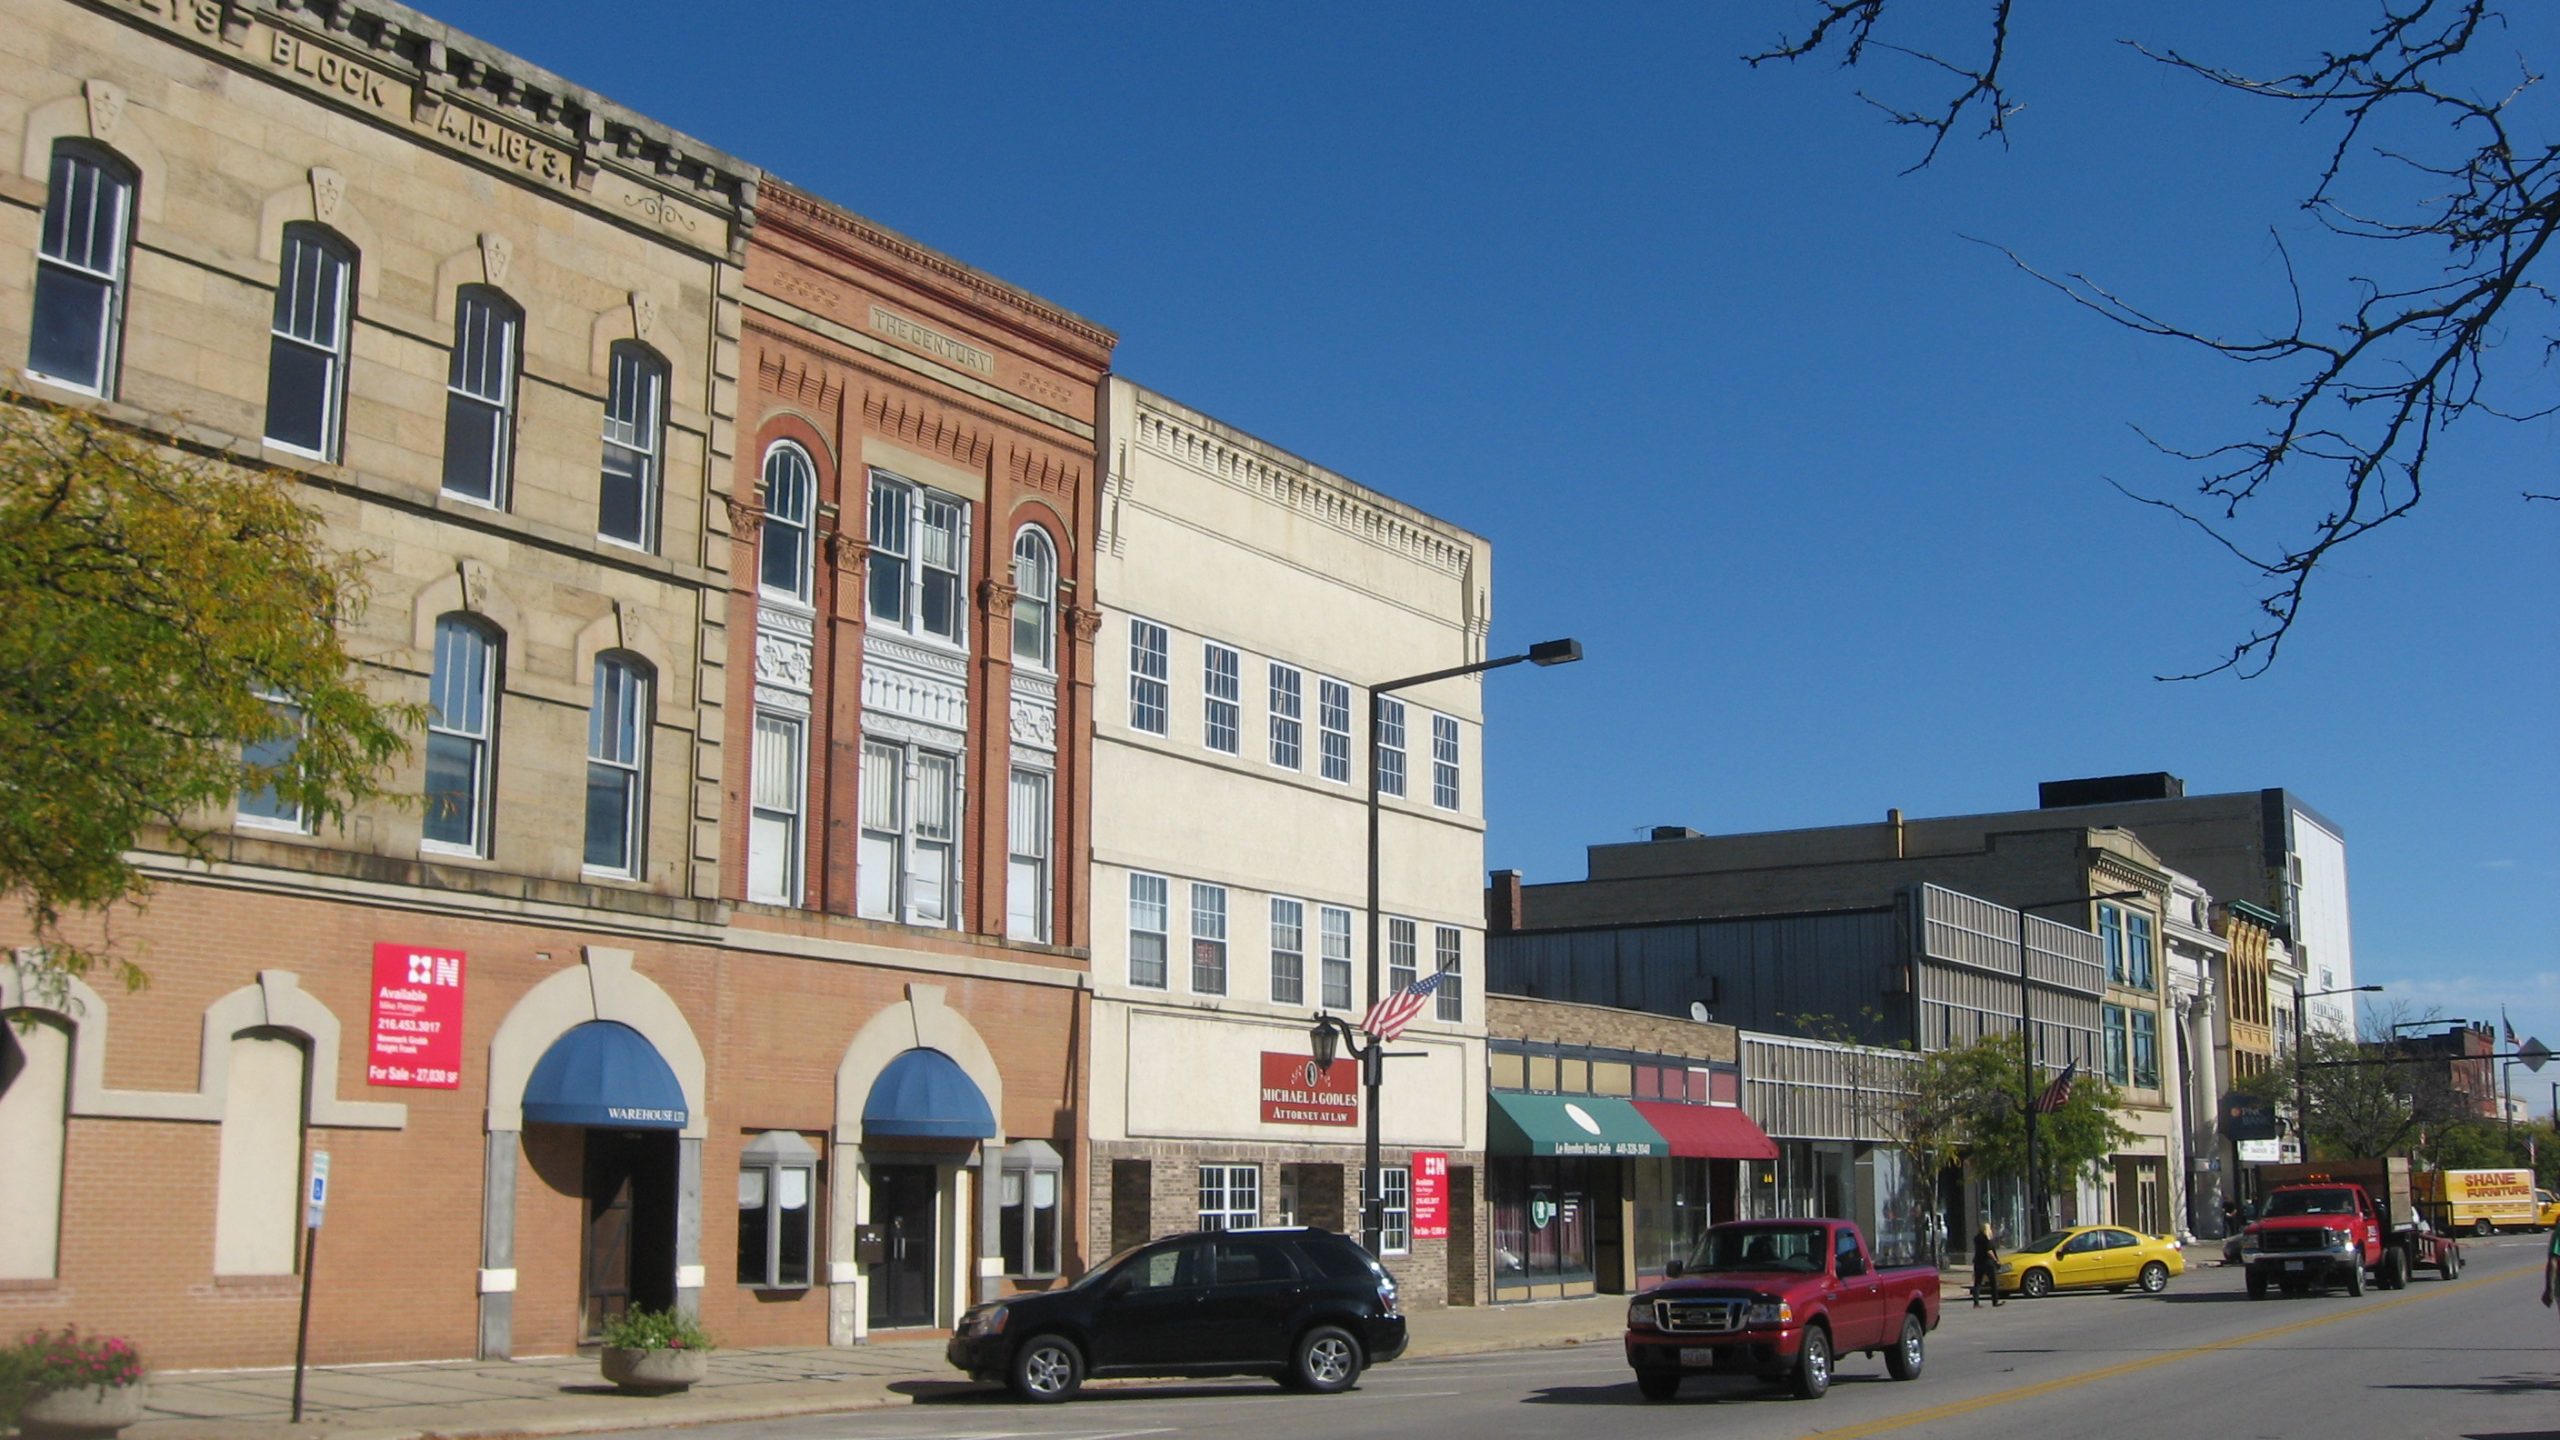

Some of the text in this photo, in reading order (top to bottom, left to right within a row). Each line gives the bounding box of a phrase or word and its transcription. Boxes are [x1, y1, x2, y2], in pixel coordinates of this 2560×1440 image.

[271, 31, 384, 107] BLOCK
[875, 311, 987, 372] THE CENTURY
[379, 986, 428, 1002] Available
[369, 1065, 387, 1079] For
[388, 1066, 409, 1081] Sale
[1262, 1088, 1358, 1107] MICHAEL J. GODLES
[608, 1107, 673, 1121] WAREHOUSE
[1320, 1112, 1330, 1121] AT
[1331, 1112, 1348, 1122] LAW
[2464, 1173, 2517, 1187] SHANE
[2467, 1185, 2530, 1198] FURNITURE
